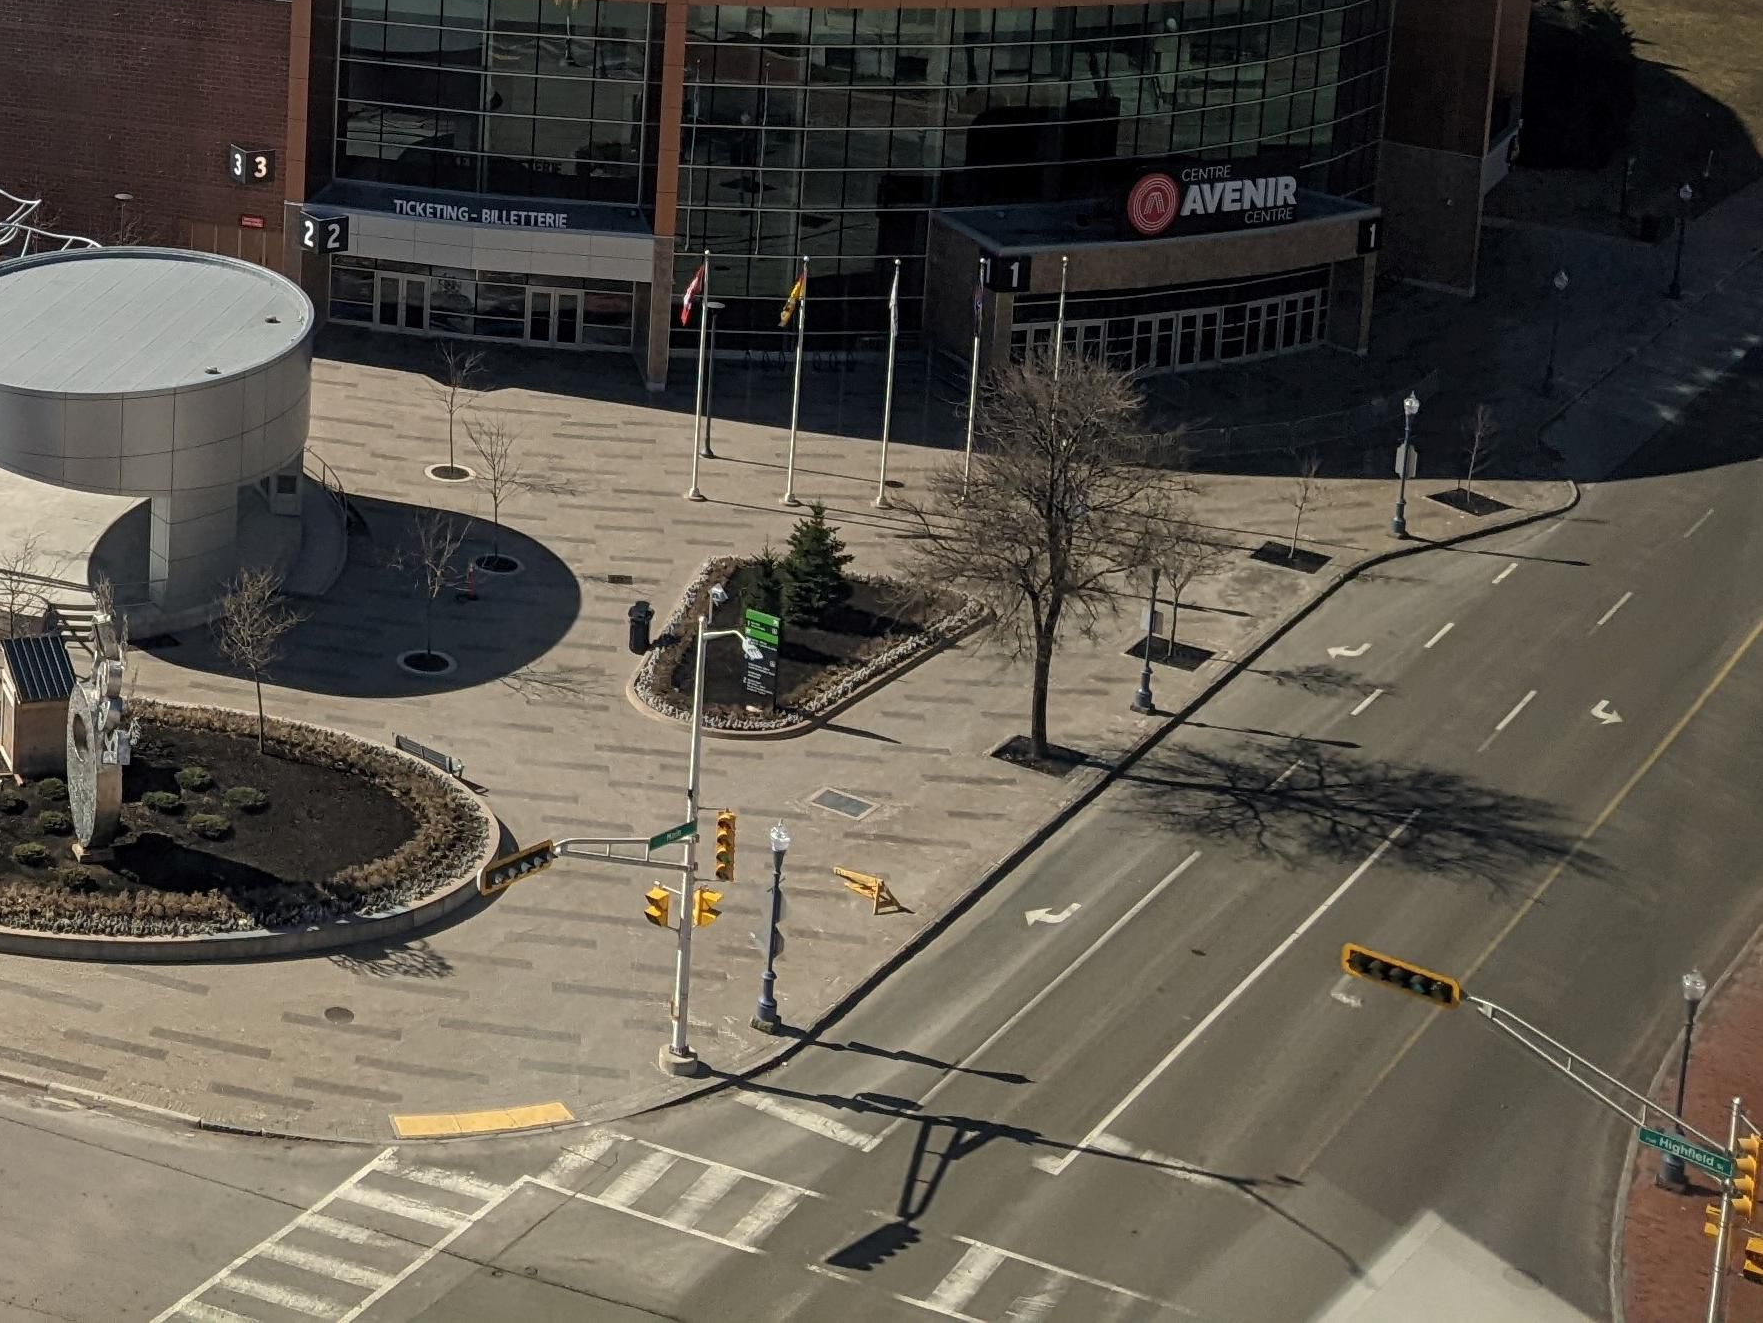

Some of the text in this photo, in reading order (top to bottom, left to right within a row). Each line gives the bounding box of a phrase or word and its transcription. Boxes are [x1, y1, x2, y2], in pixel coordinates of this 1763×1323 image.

[233, 153, 242, 176] 3
[254, 156, 267, 178] 3
[1181, 165, 1232, 182] CENTRE
[1180, 175, 1297, 216] AVENIR
[393, 199, 469, 222] TICKETING
[482, 209, 568, 228] BILLETTERIE
[1244, 207, 1294, 224] CENTRE
[304, 220, 313, 247] 2
[327, 223, 341, 249] 2
[1369, 223, 1377, 248] 1
[1010, 261, 1020, 287] 1
[1659, 1137, 1715, 1167] Highfield
